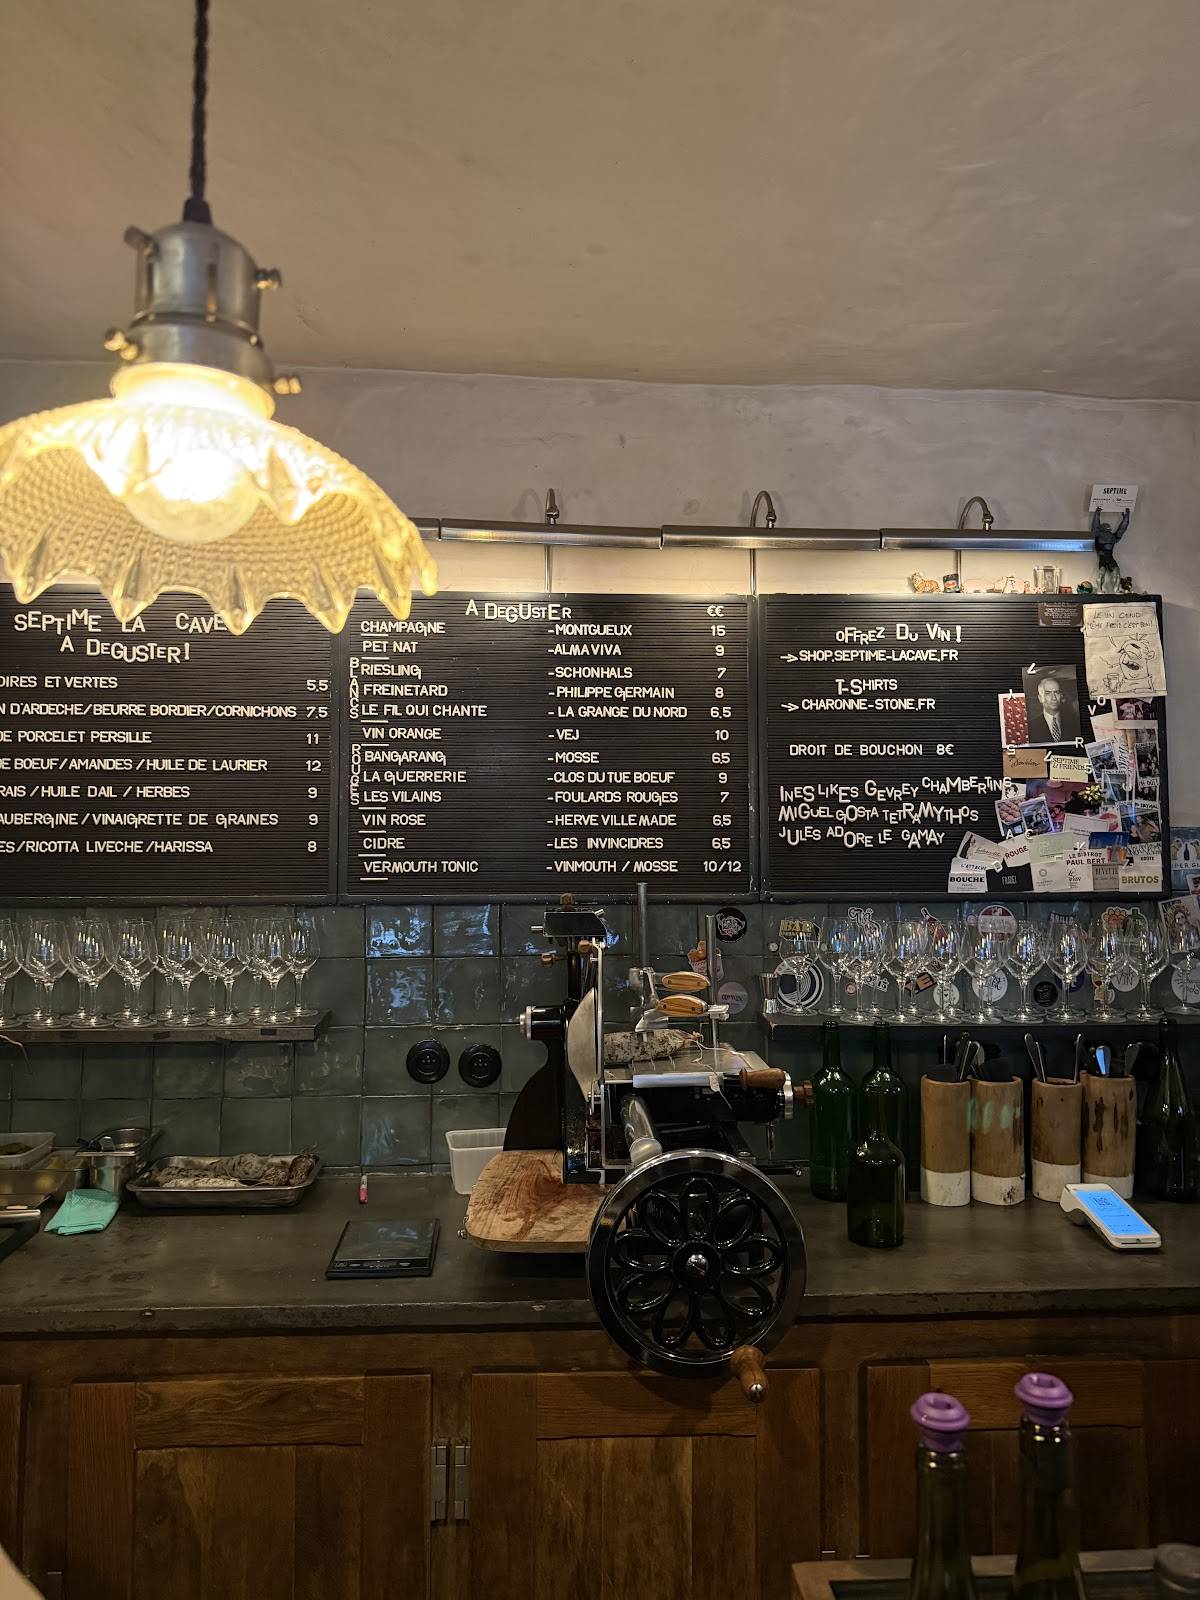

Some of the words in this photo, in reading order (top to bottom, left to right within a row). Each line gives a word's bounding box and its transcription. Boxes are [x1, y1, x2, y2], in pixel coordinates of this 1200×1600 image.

[466, 600, 478, 615] A
[15, 609, 102, 634] SEPTIME
[121, 615, 145, 633] LA
[176, 612, 227, 634] CAVE
[361, 621, 445, 636] CHAMPAGNE
[711, 625, 725, 636] 15
[61, 636, 74, 652] A
[363, 641, 388, 652] PET
[393, 641, 418, 652] NAT
[715, 645, 724, 656] 9
[361, 664, 422, 680] RIESLING
[718, 668, 726, 678] 7
[45, 676, 61, 687] ET
[64, 677, 117, 688] VERTES
[307, 680, 328, 691] 5.5
[364, 684, 447, 696] FREINETARD
[614, 687, 674, 701] GERMAIN
[715, 687, 723, 698] 8
[307, 707, 328, 718] 7.5
[362, 704, 378, 715] LE
[384, 704, 402, 715] FIL
[406, 705, 428, 716] QUI
[433, 705, 487, 716] CHANTE
[578, 706, 629, 717] GRANGE
[633, 707, 651, 717] DU
[654, 707, 687, 717] NORD
[711, 707, 731, 718] 6.5
[18, 731, 85, 742] PORCELET
[91, 731, 152, 743] PERSILLE
[307, 733, 318, 744] 11
[362, 728, 384, 739] VIN
[389, 728, 441, 739] ORANGE
[715, 730, 729, 740] 10
[790, 745, 827, 755] DROIT
[835, 745, 852, 755] DE
[860, 744, 922, 755] BOUCHON
[936, 744, 954, 755] 8€
[365, 751, 446, 766] BANGARANG
[0, 758, 11, 769] E
[188, 759, 207, 770] DE
[213, 760, 267, 771] LAURIER
[306, 760, 321, 771] 12
[364, 771, 380, 782] LA
[384, 771, 466, 785] GUERRERIE
[588, 772, 605, 782] DU
[607, 772, 631, 783] TUE
[634, 772, 675, 783] BOEUF
[719, 773, 727, 783] 9
[88, 786, 117, 797] DAIL
[137, 786, 190, 797] HERBES
[308, 787, 317, 798] 9
[364, 791, 388, 802] LES
[392, 791, 441, 802] VILAINS
[721, 792, 729, 802] 7
[780, 786, 814, 802] INES
[627, 792, 678, 806] ROUGES
[779, 803, 834, 821] MIGUEL
[189, 814, 208, 825] DE
[216, 814, 278, 828] GRAINES
[309, 814, 318, 825] 9
[362, 814, 386, 825] VIN
[391, 814, 426, 825] ROSE
[779, 826, 821, 845] JULES
[827, 826, 873, 847] ADORE
[879, 829, 892, 843] LE
[902, 829, 944, 848] GAMAY
[308, 841, 316, 852] 8
[363, 838, 405, 849] CIDRE
[588, 838, 663, 849] INVINCIDRES
[1005, 845, 1029, 860] ROUGE
[364, 861, 437, 873] VERMOUTH
[441, 861, 478, 872] TONIC
[634, 861, 678, 872] MOSSE
[704, 861, 741, 872] 10/12
[1121, 876, 1159, 884] BRUTOS
